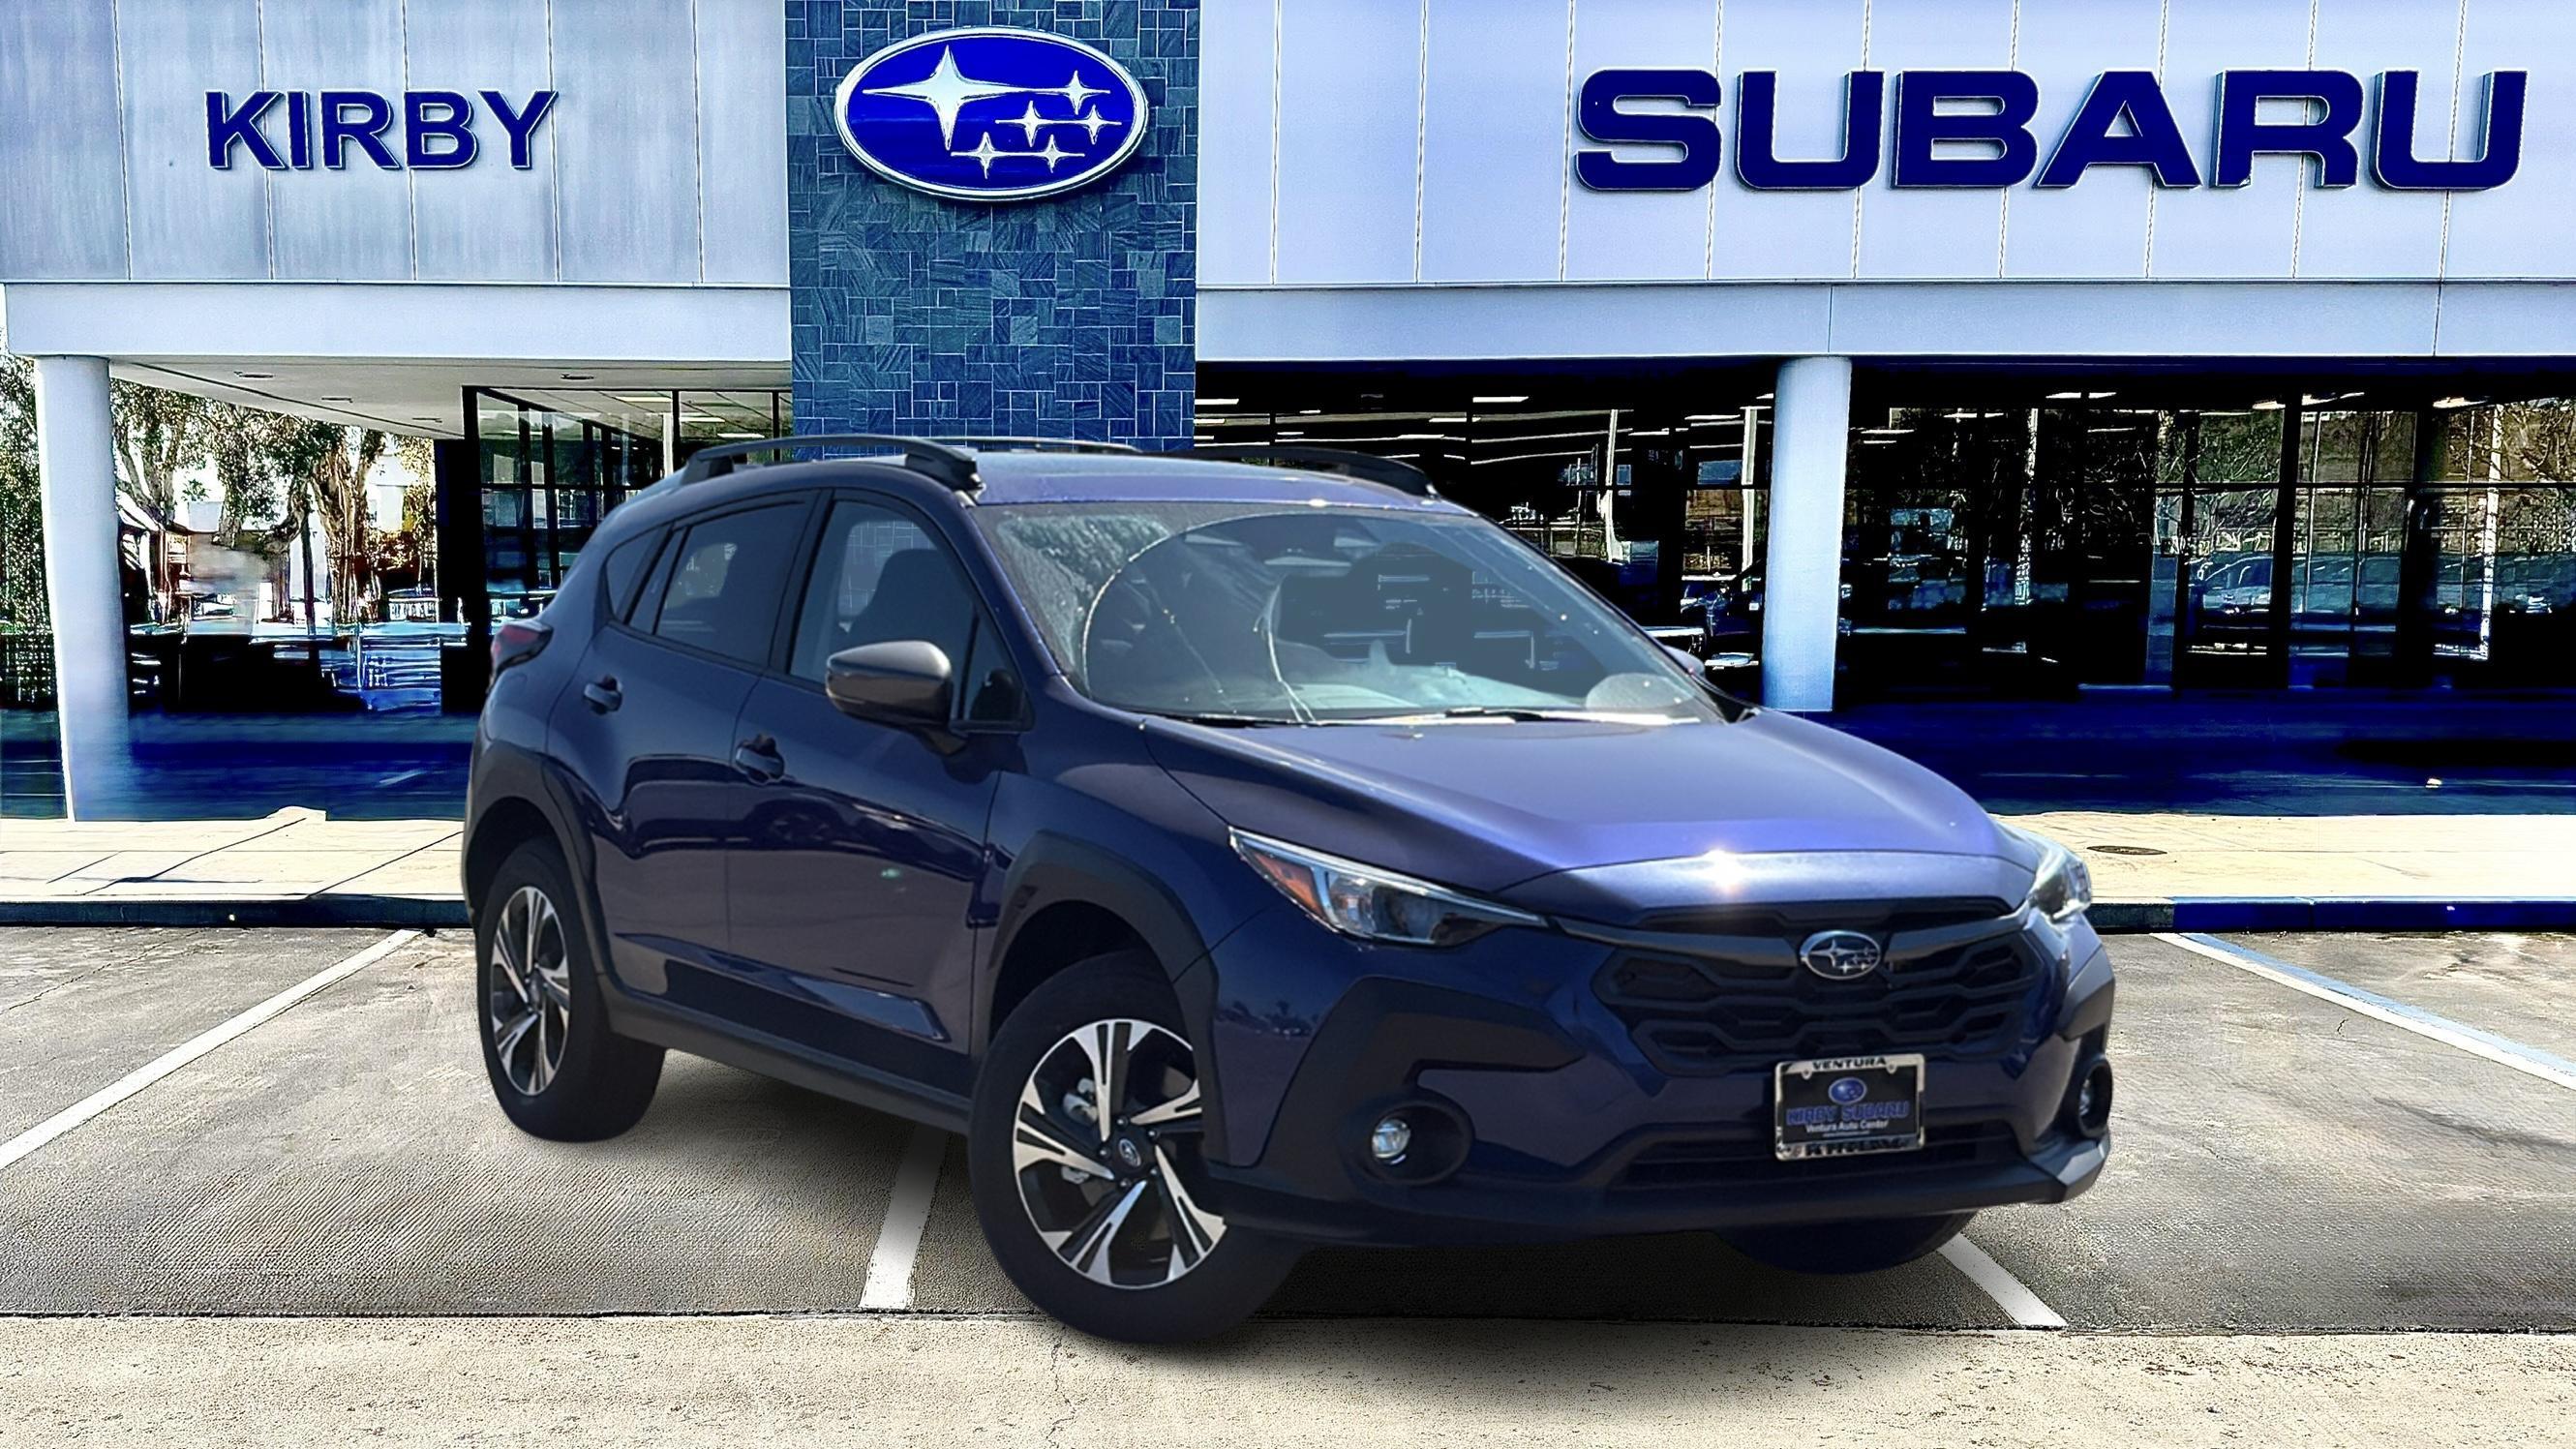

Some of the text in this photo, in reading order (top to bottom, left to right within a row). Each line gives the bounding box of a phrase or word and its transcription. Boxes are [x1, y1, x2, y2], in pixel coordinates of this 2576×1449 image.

[205, 90, 559, 170] KIRBY
[1575, 69, 2529, 192] SUBARU
[1812, 1057, 1888, 1071] VENTURA
[1786, 1101, 1910, 1126] KIRBY SUBARU
[1805, 1119, 1889, 1133] Ventura Auto Center
